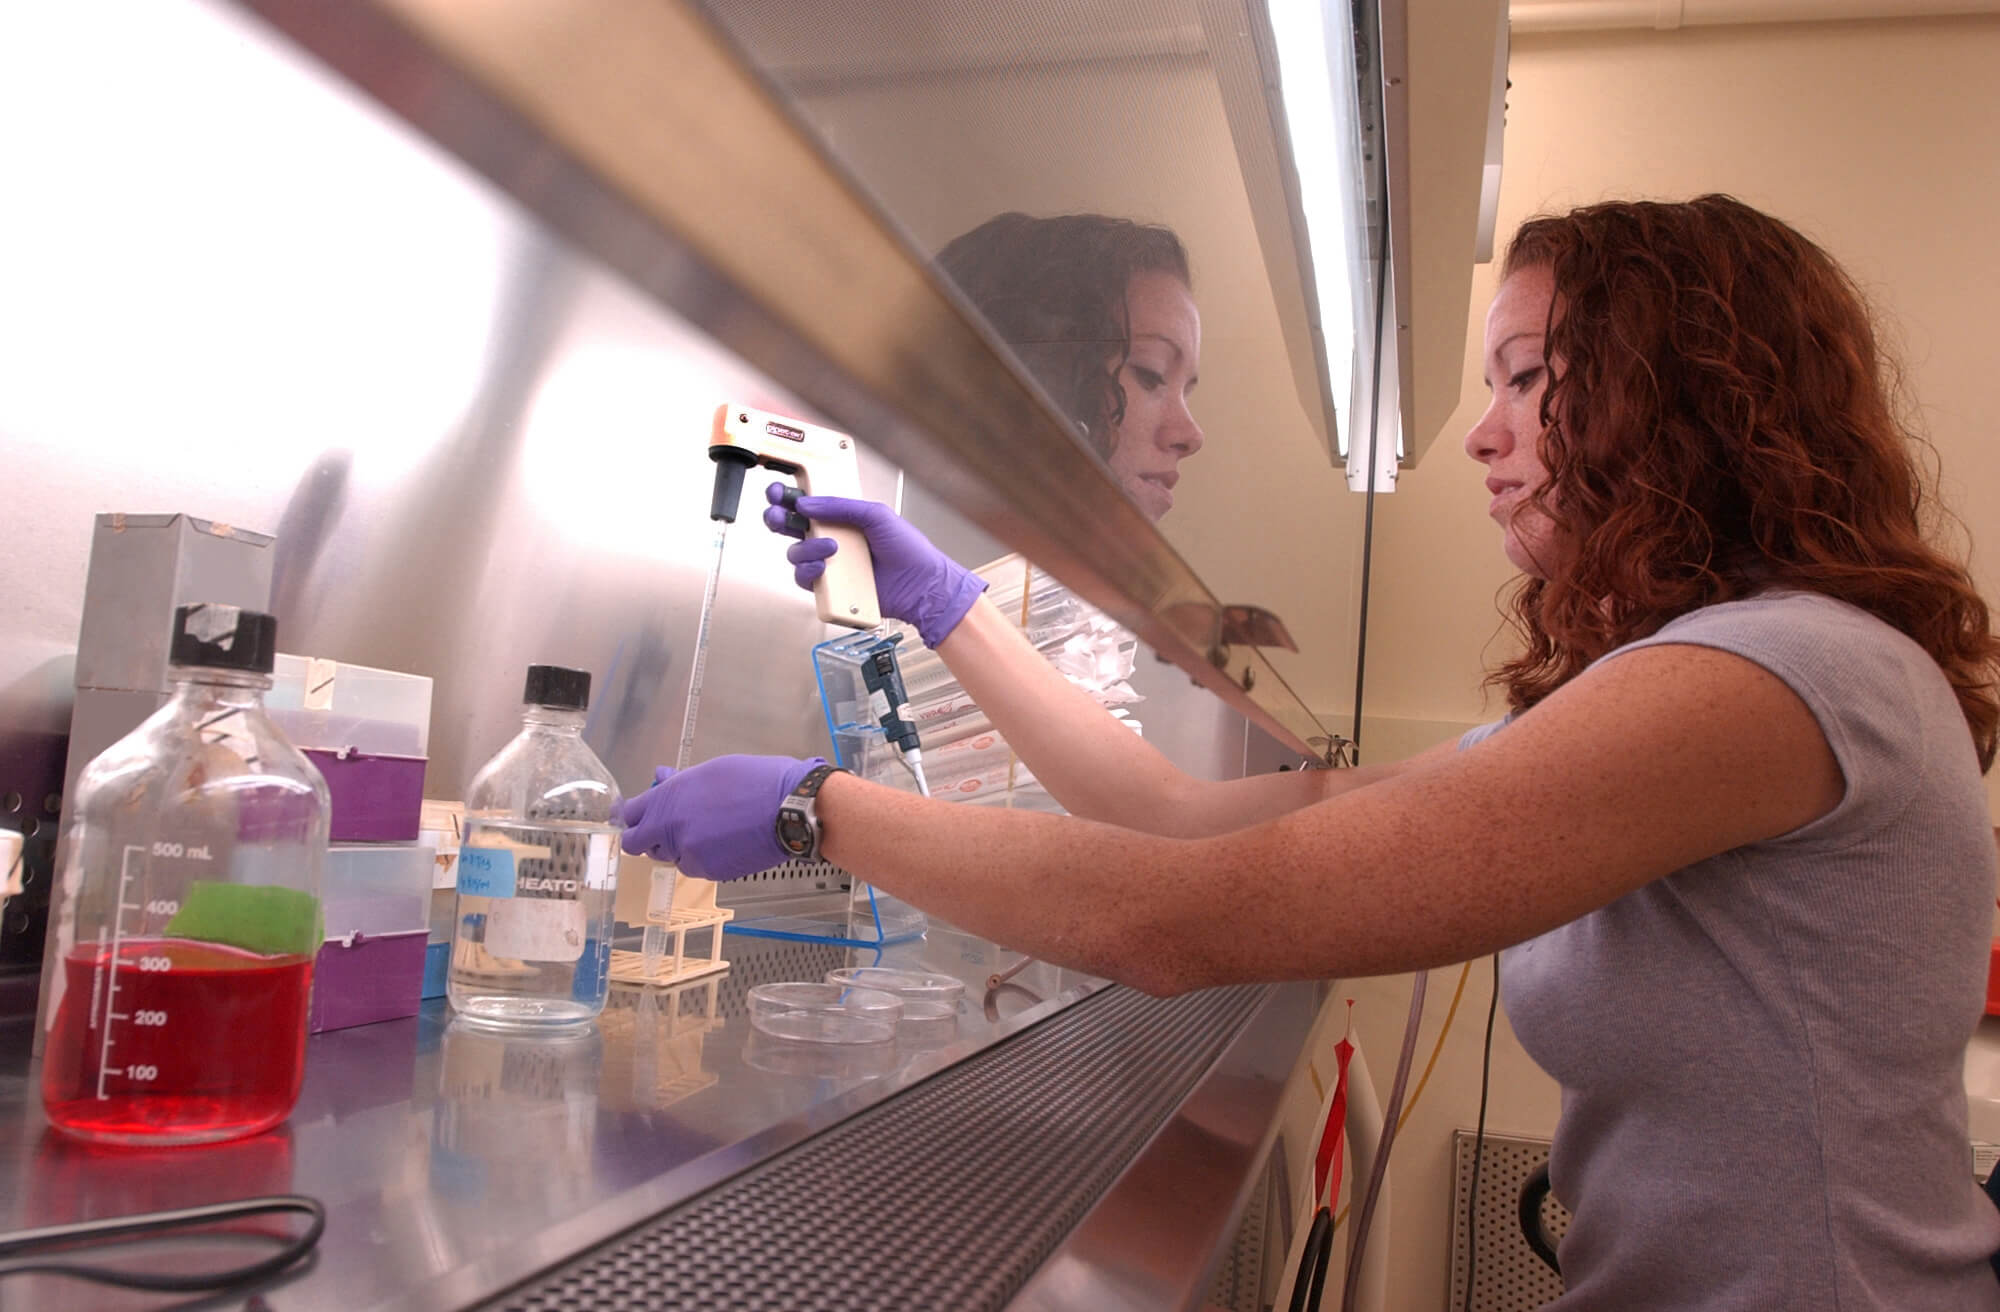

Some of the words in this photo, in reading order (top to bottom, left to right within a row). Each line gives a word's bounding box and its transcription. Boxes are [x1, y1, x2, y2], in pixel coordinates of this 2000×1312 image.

[152, 842, 183, 858] 500
[187, 845, 213, 860] mL
[146, 900, 178, 915] 400
[139, 956, 171, 972] 300
[134, 1010, 167, 1027] 200
[127, 1065, 158, 1081] 100
